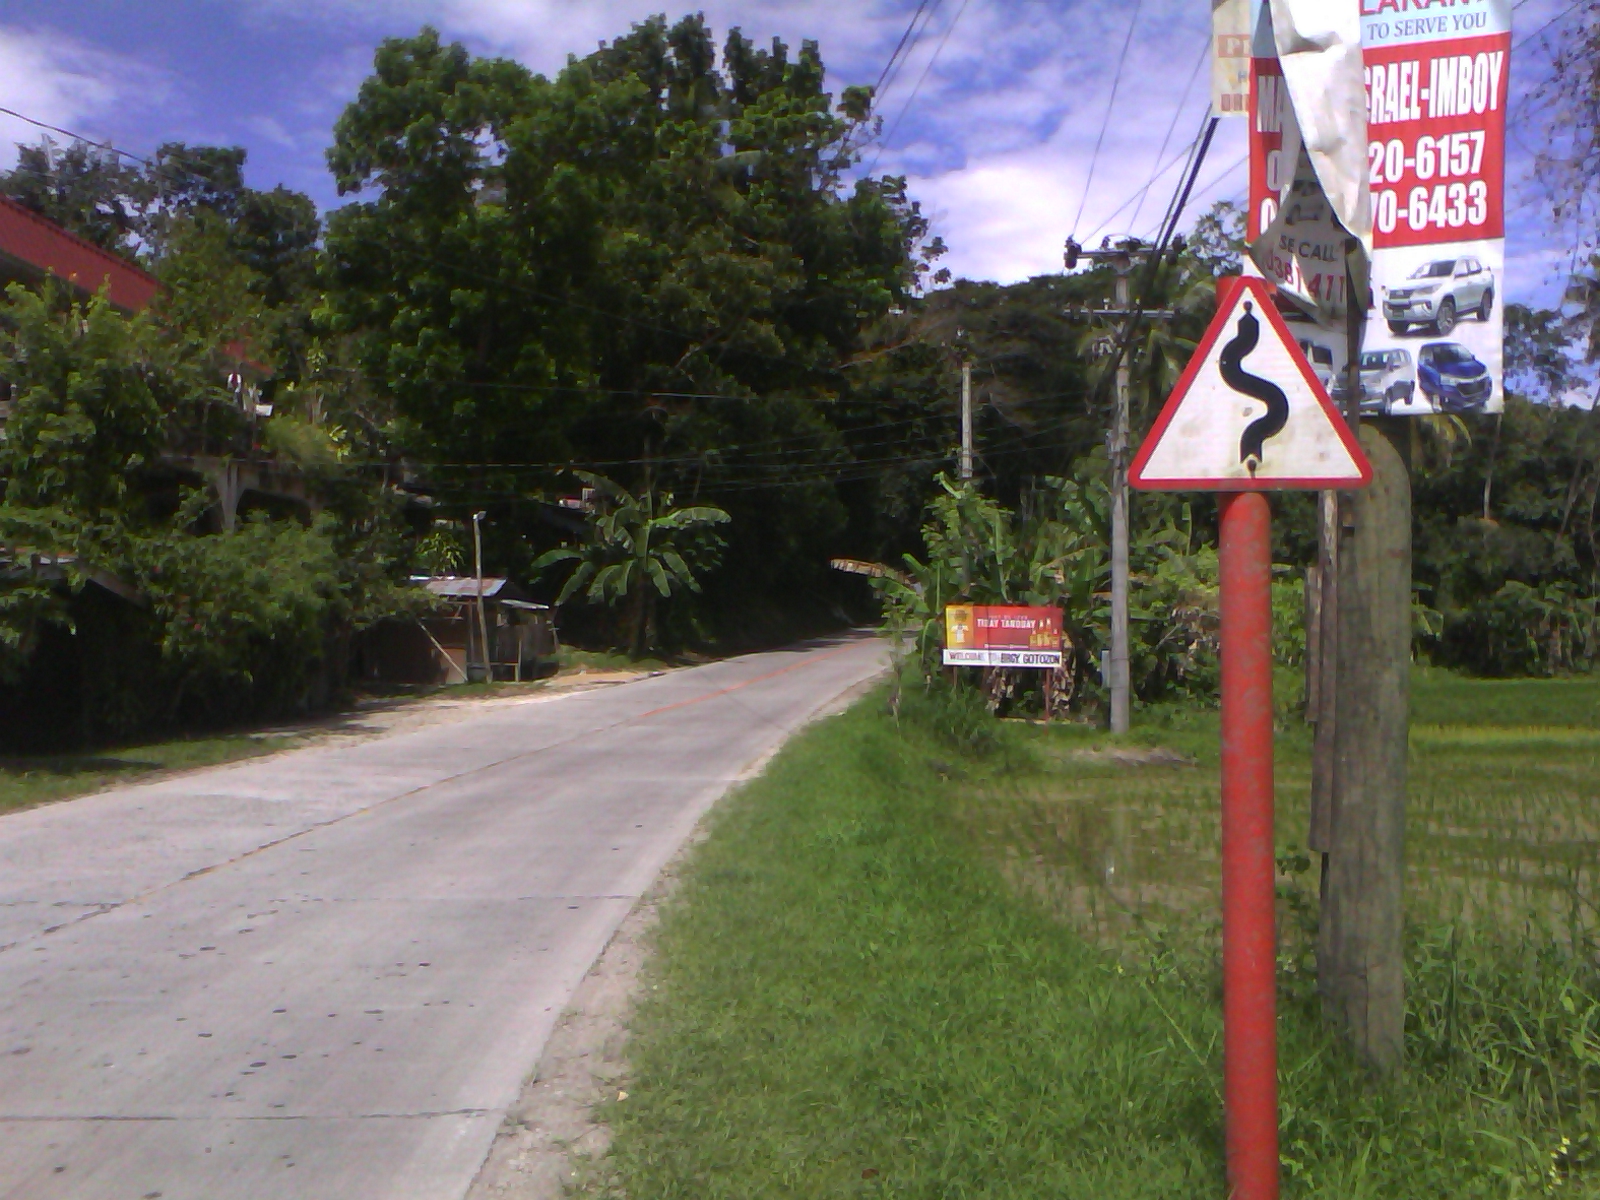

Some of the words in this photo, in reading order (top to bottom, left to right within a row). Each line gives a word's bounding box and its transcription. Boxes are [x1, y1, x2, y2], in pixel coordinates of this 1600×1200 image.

[1367, 22, 1390, 41] TO
[1394, 15, 1448, 38] SERVE
[1452, 11, 1487, 31] YOU
[1368, 130, 1486, 185] 20-6157
[1299, 241, 1338, 263] CALL
